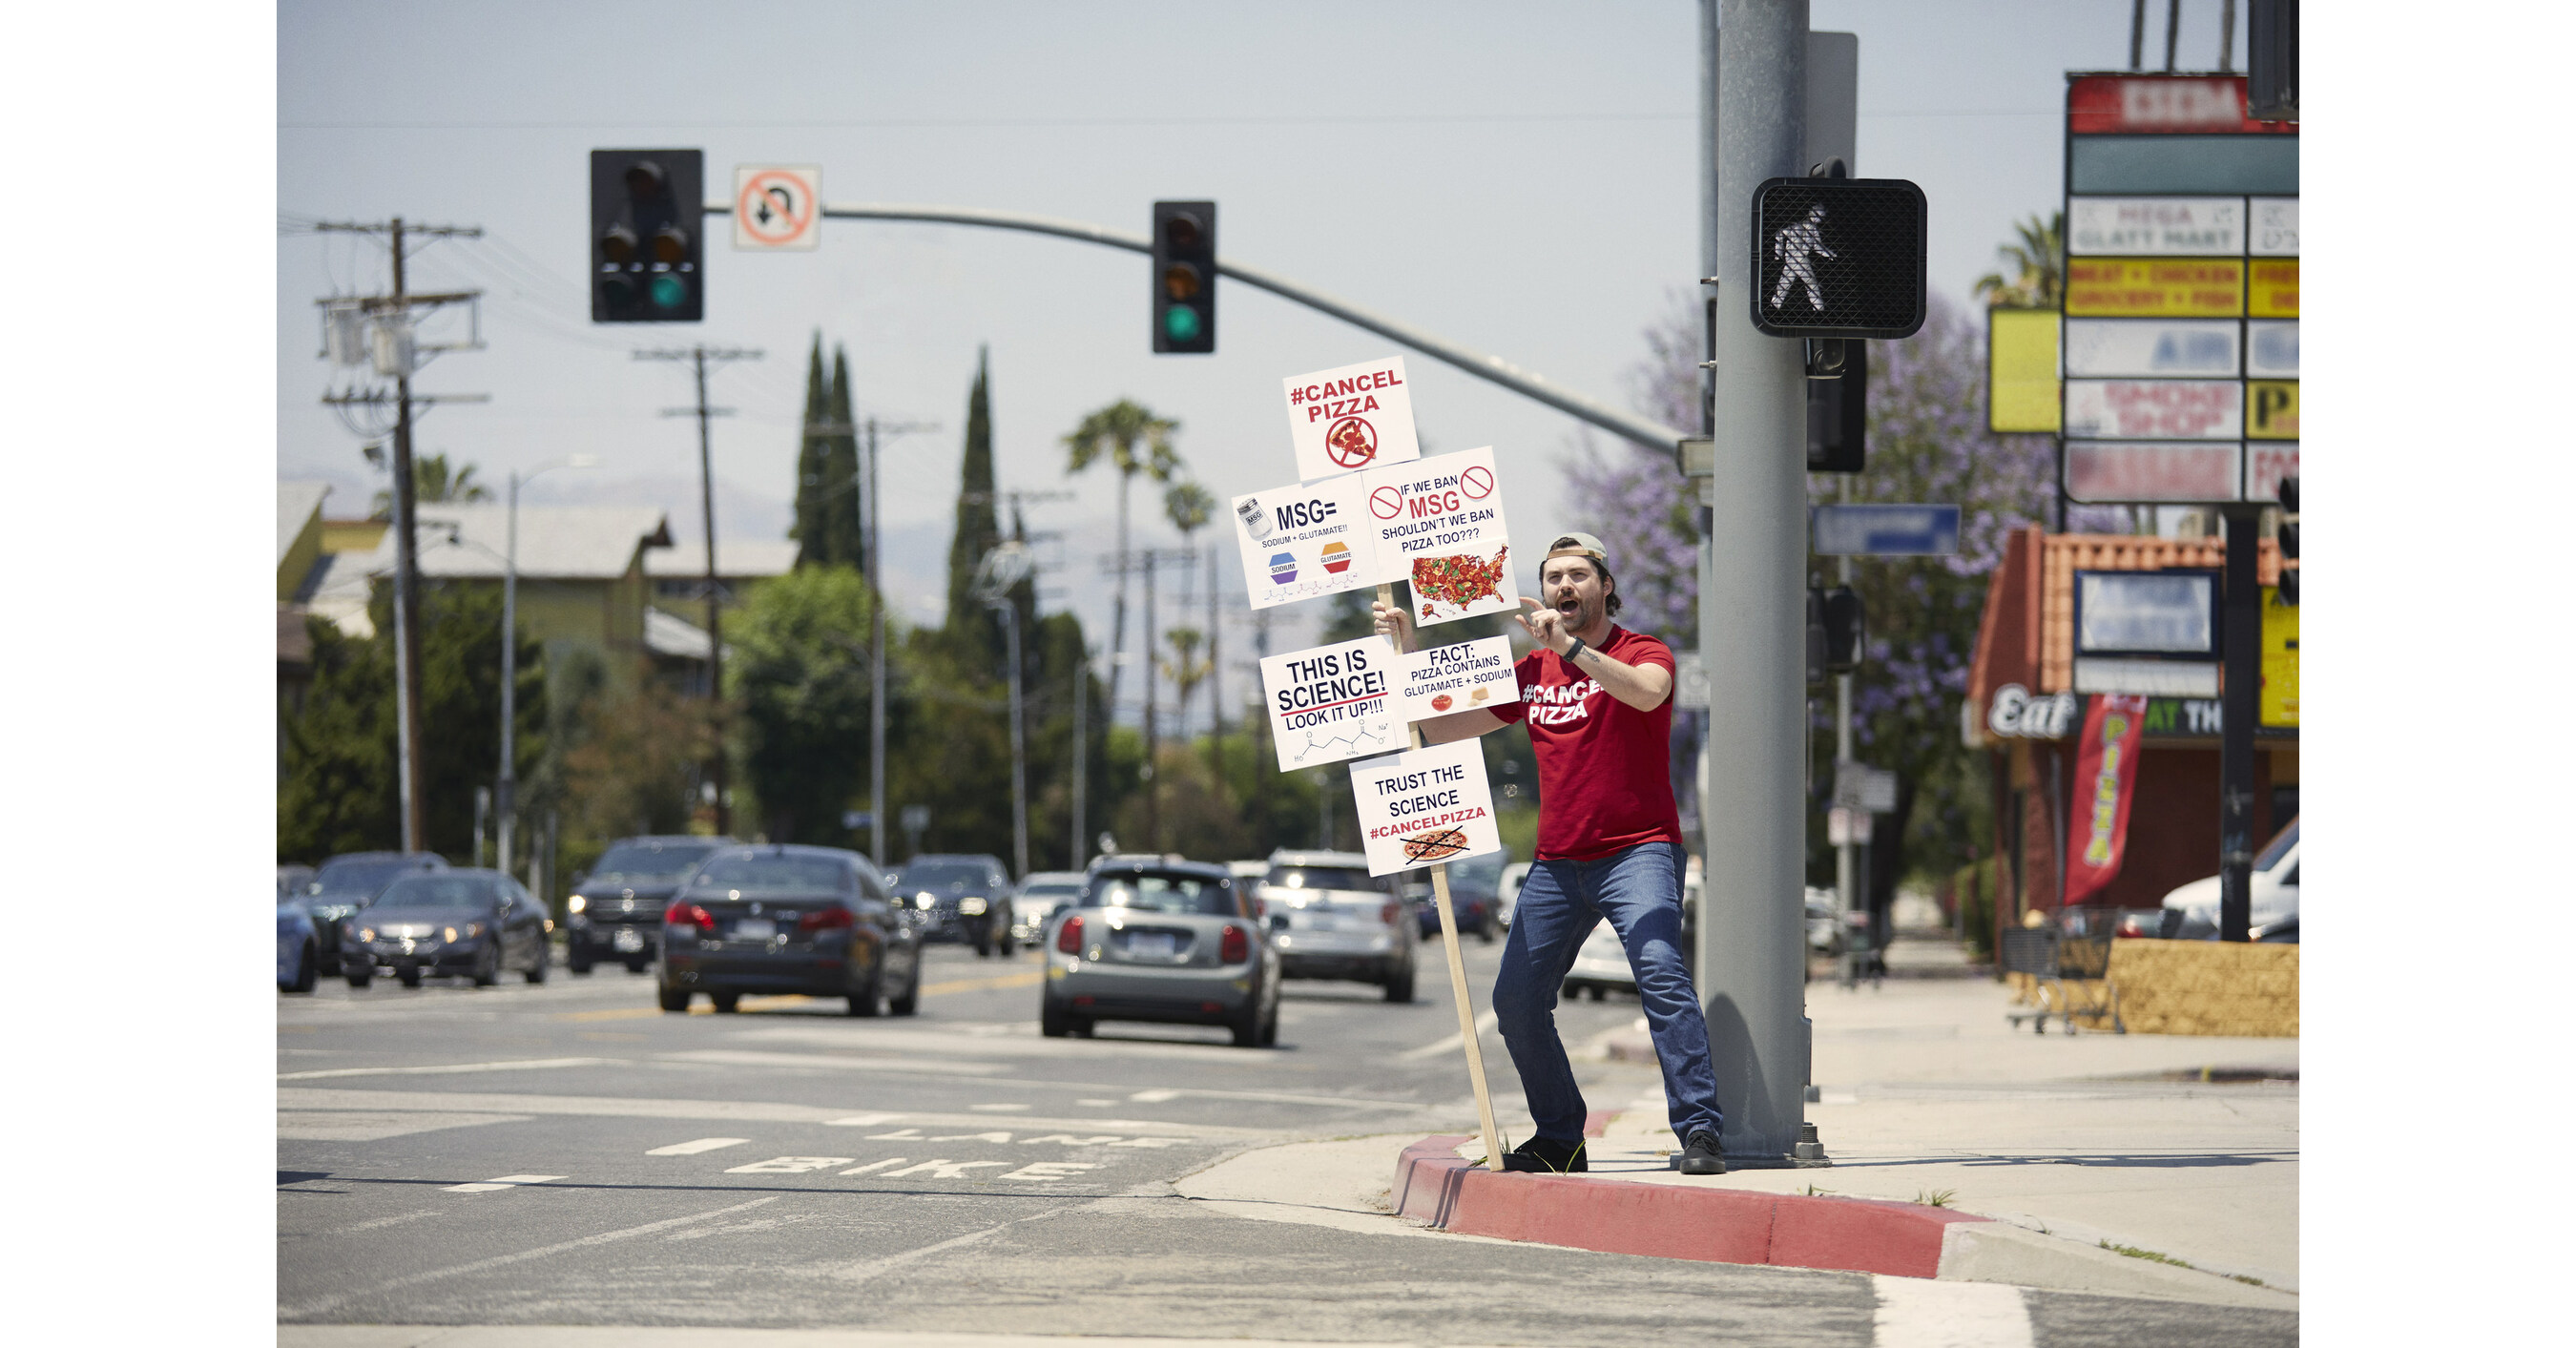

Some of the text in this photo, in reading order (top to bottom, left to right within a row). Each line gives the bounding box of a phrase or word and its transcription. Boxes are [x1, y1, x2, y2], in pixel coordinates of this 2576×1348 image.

[1291, 369, 1403, 405] #CANCEL
[1307, 395, 1380, 423] PIZZA
[1400, 474, 1459, 496] IF WE BAN
[1246, 510, 1262, 525] MSG
[1276, 499, 1338, 531] MSG=
[1408, 490, 1460, 519] MSG
[1261, 535, 1292, 549] SODIUM
[1298, 524, 1348, 541] GLUTAMATE!!
[1381, 508, 1494, 540] SHOULDN'T WE BAN
[1402, 528, 1480, 552] PIZZA TOO???
[1271, 563, 1297, 574] SODIUM
[1319, 551, 1352, 564] GLUTAMATE
[1286, 649, 1367, 684] THIS IS
[1411, 654, 1501, 682] PIZZA CONTAINS
[1429, 644, 1475, 666] FACT:
[1278, 670, 1386, 712] SCIENCE!
[1403, 677, 1464, 697] GLUTAMATE
[1473, 668, 1513, 684] SODIUM
[1522, 679, 1605, 704] #CANCE
[1285, 698, 1383, 731] LOOK IT UP!!!
[1528, 700, 1589, 725] PIZZA
[1989, 684, 2076, 739] Eat
[1375, 764, 1465, 796] TRUST THE
[2083, 713, 2129, 867] PIZZA
[1389, 789, 1460, 818] SCIENCE
[1369, 806, 1486, 840] #CANCELPIZZA
[862, 1129, 1198, 1148] LANE
[723, 1155, 1106, 1182] BIKE
